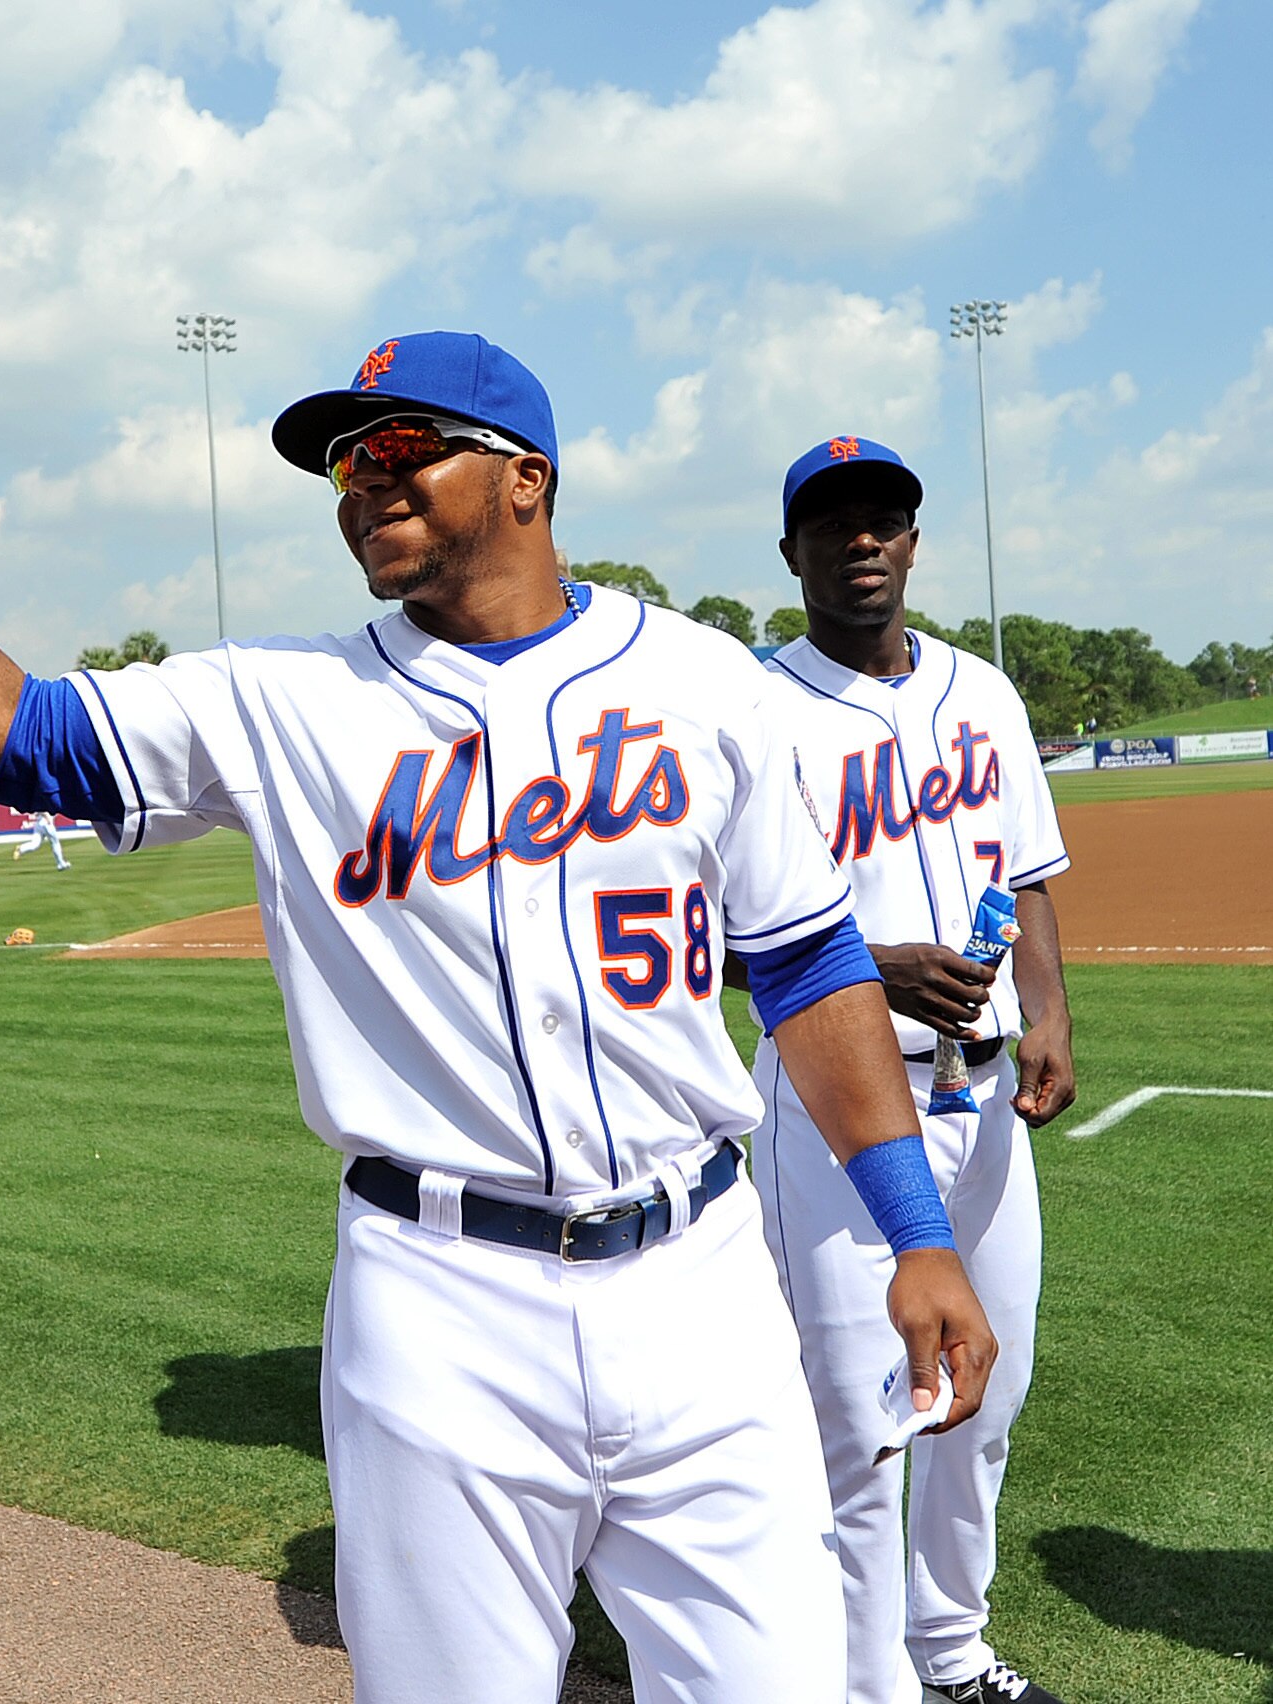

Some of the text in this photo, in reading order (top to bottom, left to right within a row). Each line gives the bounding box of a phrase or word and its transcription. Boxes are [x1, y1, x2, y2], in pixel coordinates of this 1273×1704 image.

[334, 707, 690, 909] Mets
[826, 721, 1000, 865] Mets
[1126, 739, 1156, 749] PGA
[593, 882, 713, 1010] 58
